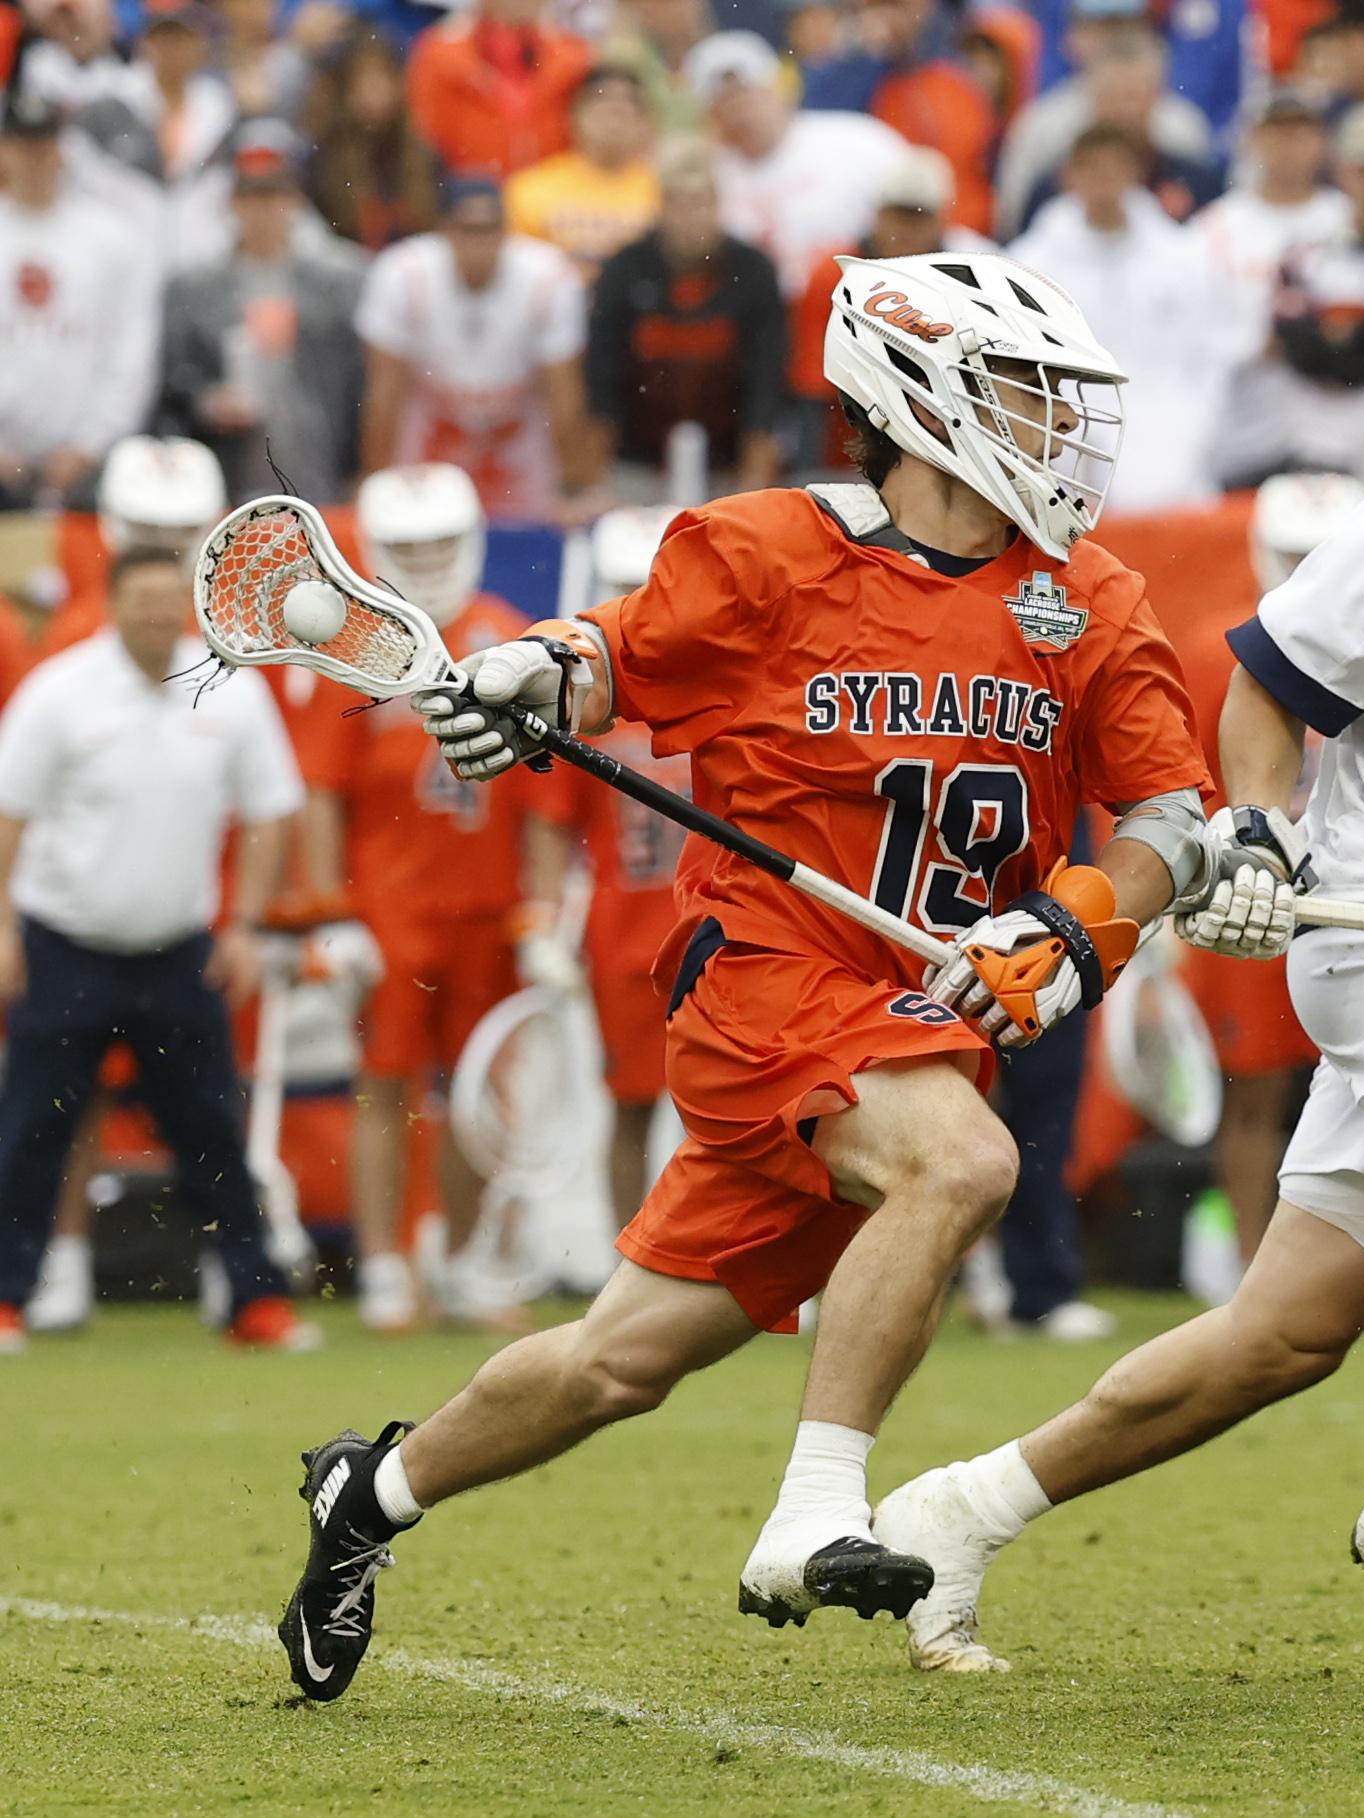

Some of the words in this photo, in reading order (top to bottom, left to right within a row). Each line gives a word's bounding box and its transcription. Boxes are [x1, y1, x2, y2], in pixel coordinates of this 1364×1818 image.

[868, 757, 1031, 933] 19
[887, 992, 962, 1025] S
[312, 1456, 352, 1529] NIKE
